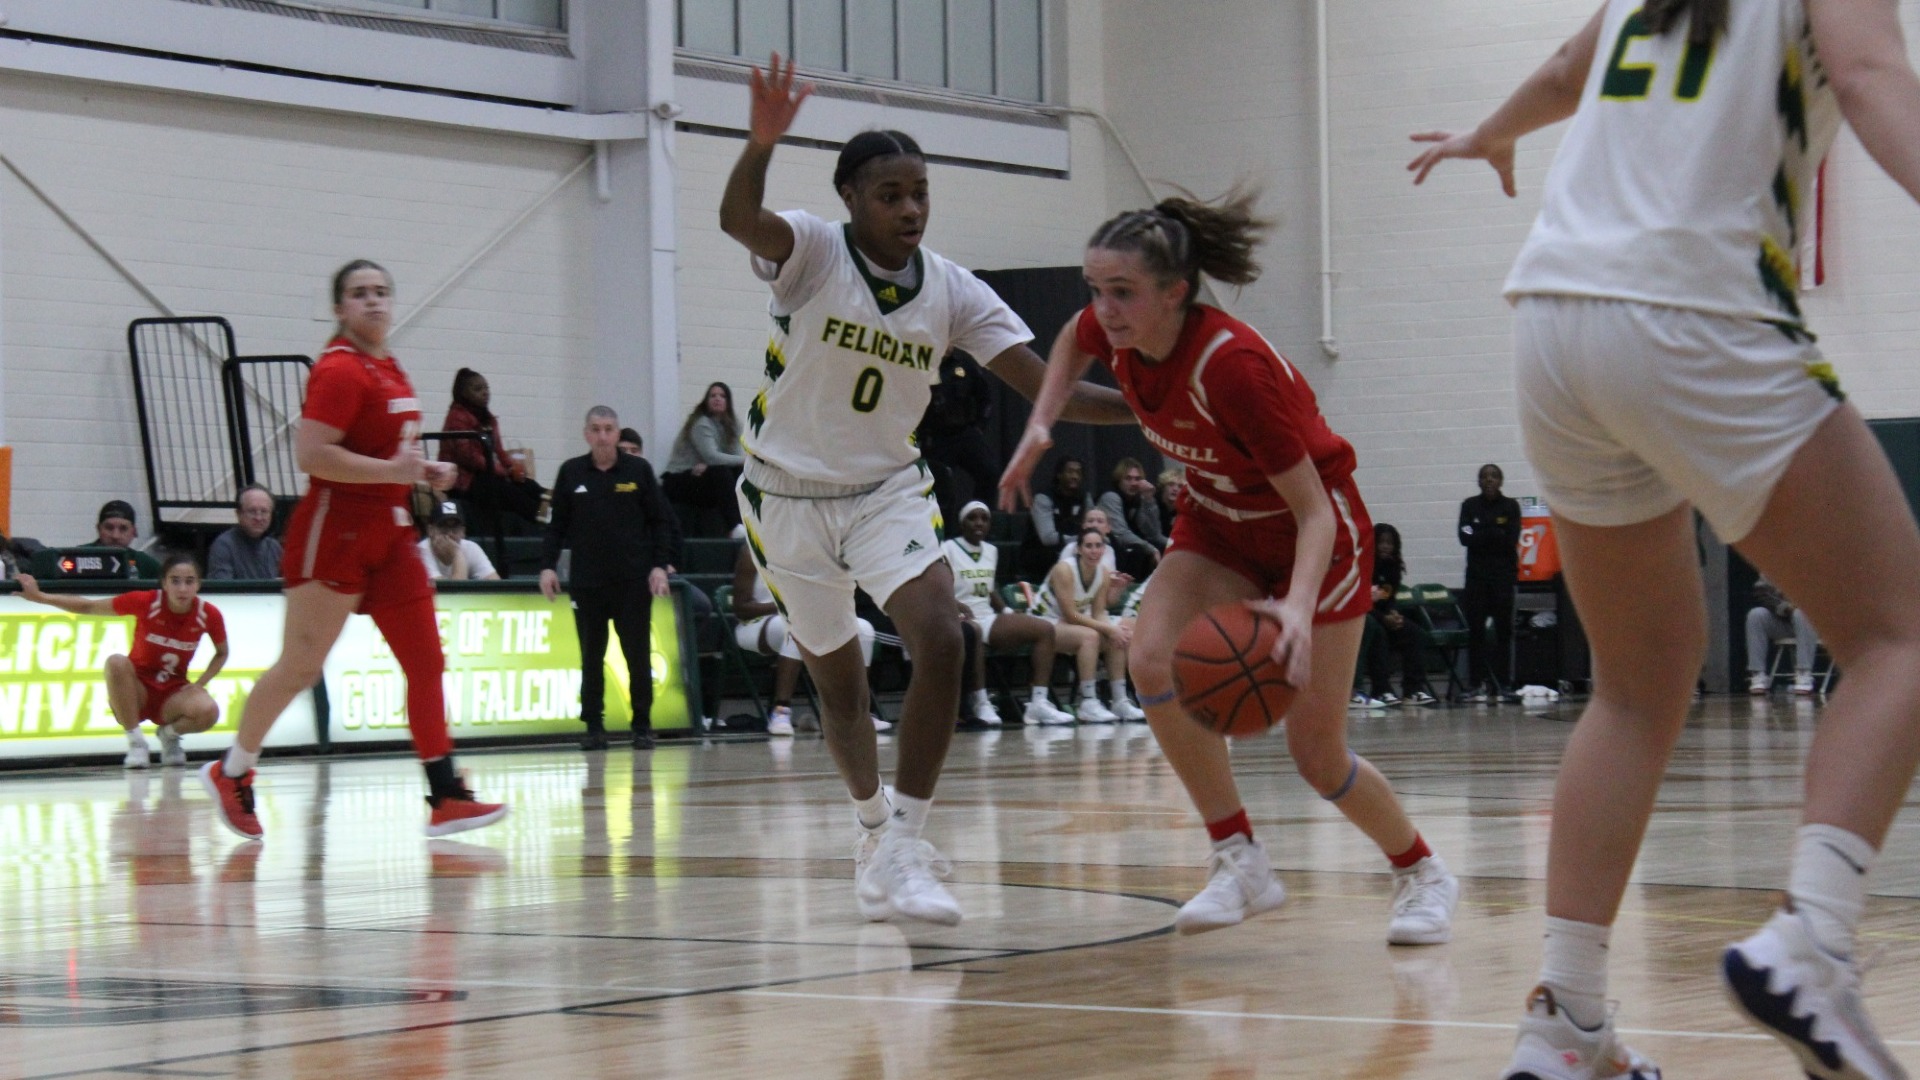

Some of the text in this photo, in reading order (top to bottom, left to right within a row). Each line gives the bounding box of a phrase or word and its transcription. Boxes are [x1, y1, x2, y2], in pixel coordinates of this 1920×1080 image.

[821, 317, 934, 371] FELICIAN
[851, 366, 884, 413] 0
[458, 610, 493, 655] OF
[497, 610, 552, 654] THE
